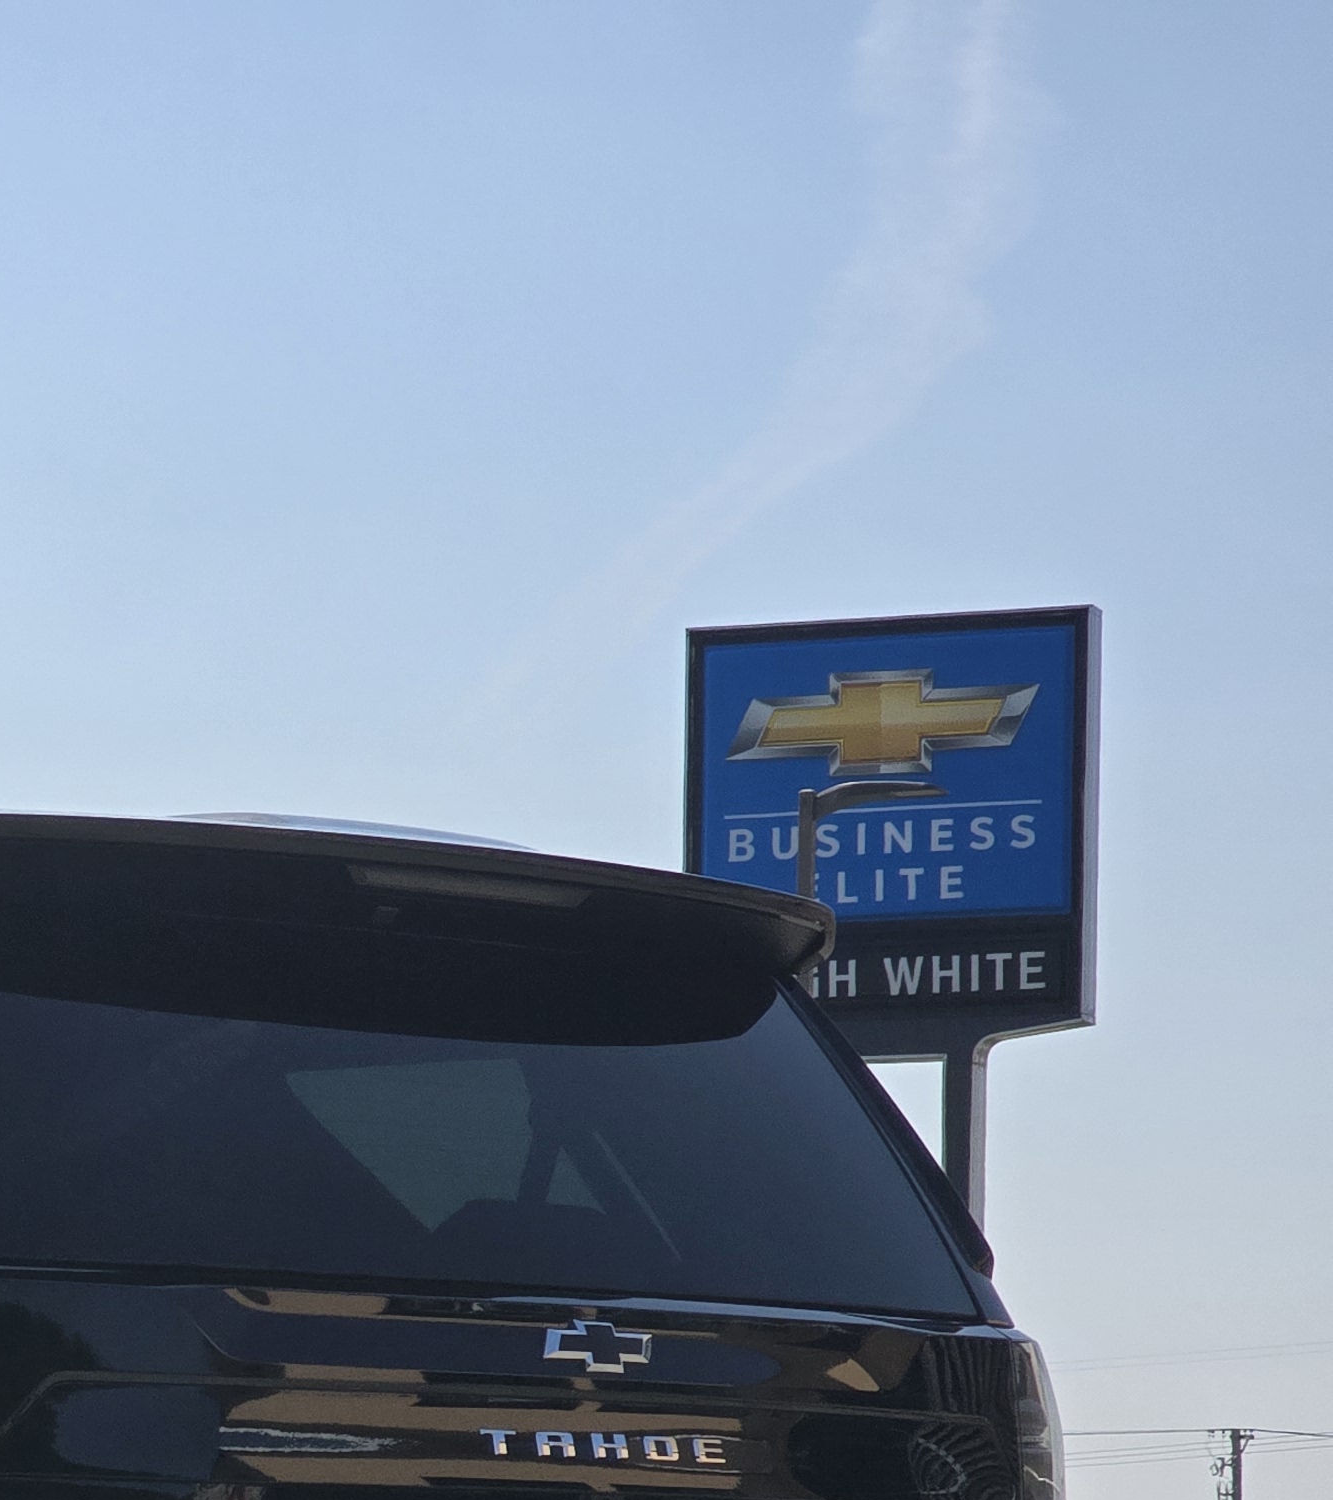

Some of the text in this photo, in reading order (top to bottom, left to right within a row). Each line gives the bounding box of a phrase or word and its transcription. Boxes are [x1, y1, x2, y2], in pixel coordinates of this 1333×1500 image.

[727, 814, 1037, 863] BUSINESS
[813, 950, 1047, 999] H WHITE
[479, 1429, 727, 1464] TAHOE
